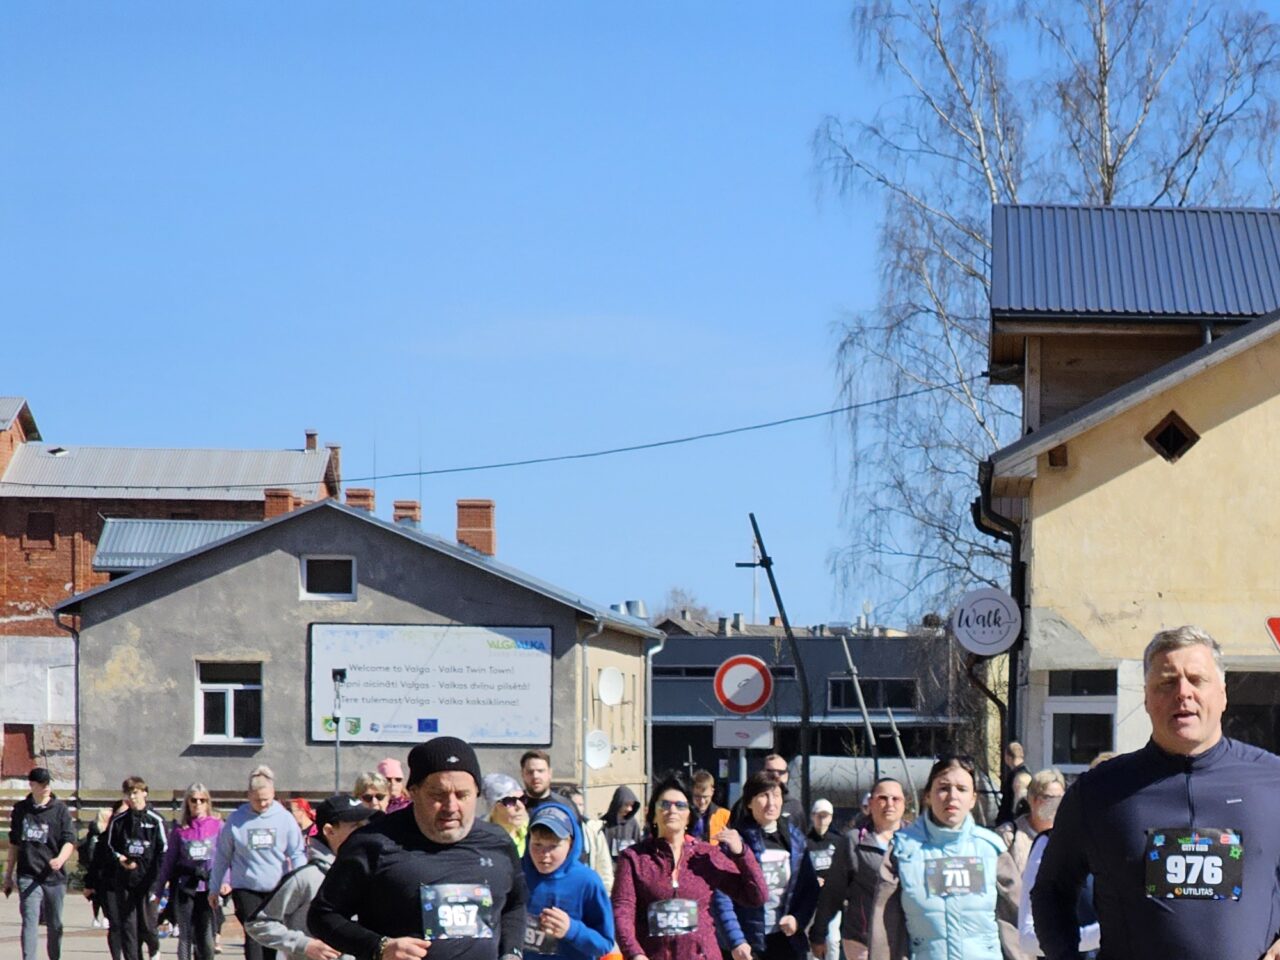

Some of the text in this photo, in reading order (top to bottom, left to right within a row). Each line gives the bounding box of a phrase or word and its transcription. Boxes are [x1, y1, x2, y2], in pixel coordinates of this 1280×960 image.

[958, 608, 1017, 628] Walk
[349, 663, 390, 673] Welcome
[393, 665, 402, 673] to
[466, 665, 486, 674] Twin
[942, 869, 971, 887] 711
[1166, 855, 1223, 884] 976
[1183, 887, 1214, 896] UTILITAS
[438, 904, 479, 927] 967
[656, 912, 689, 928] 545
